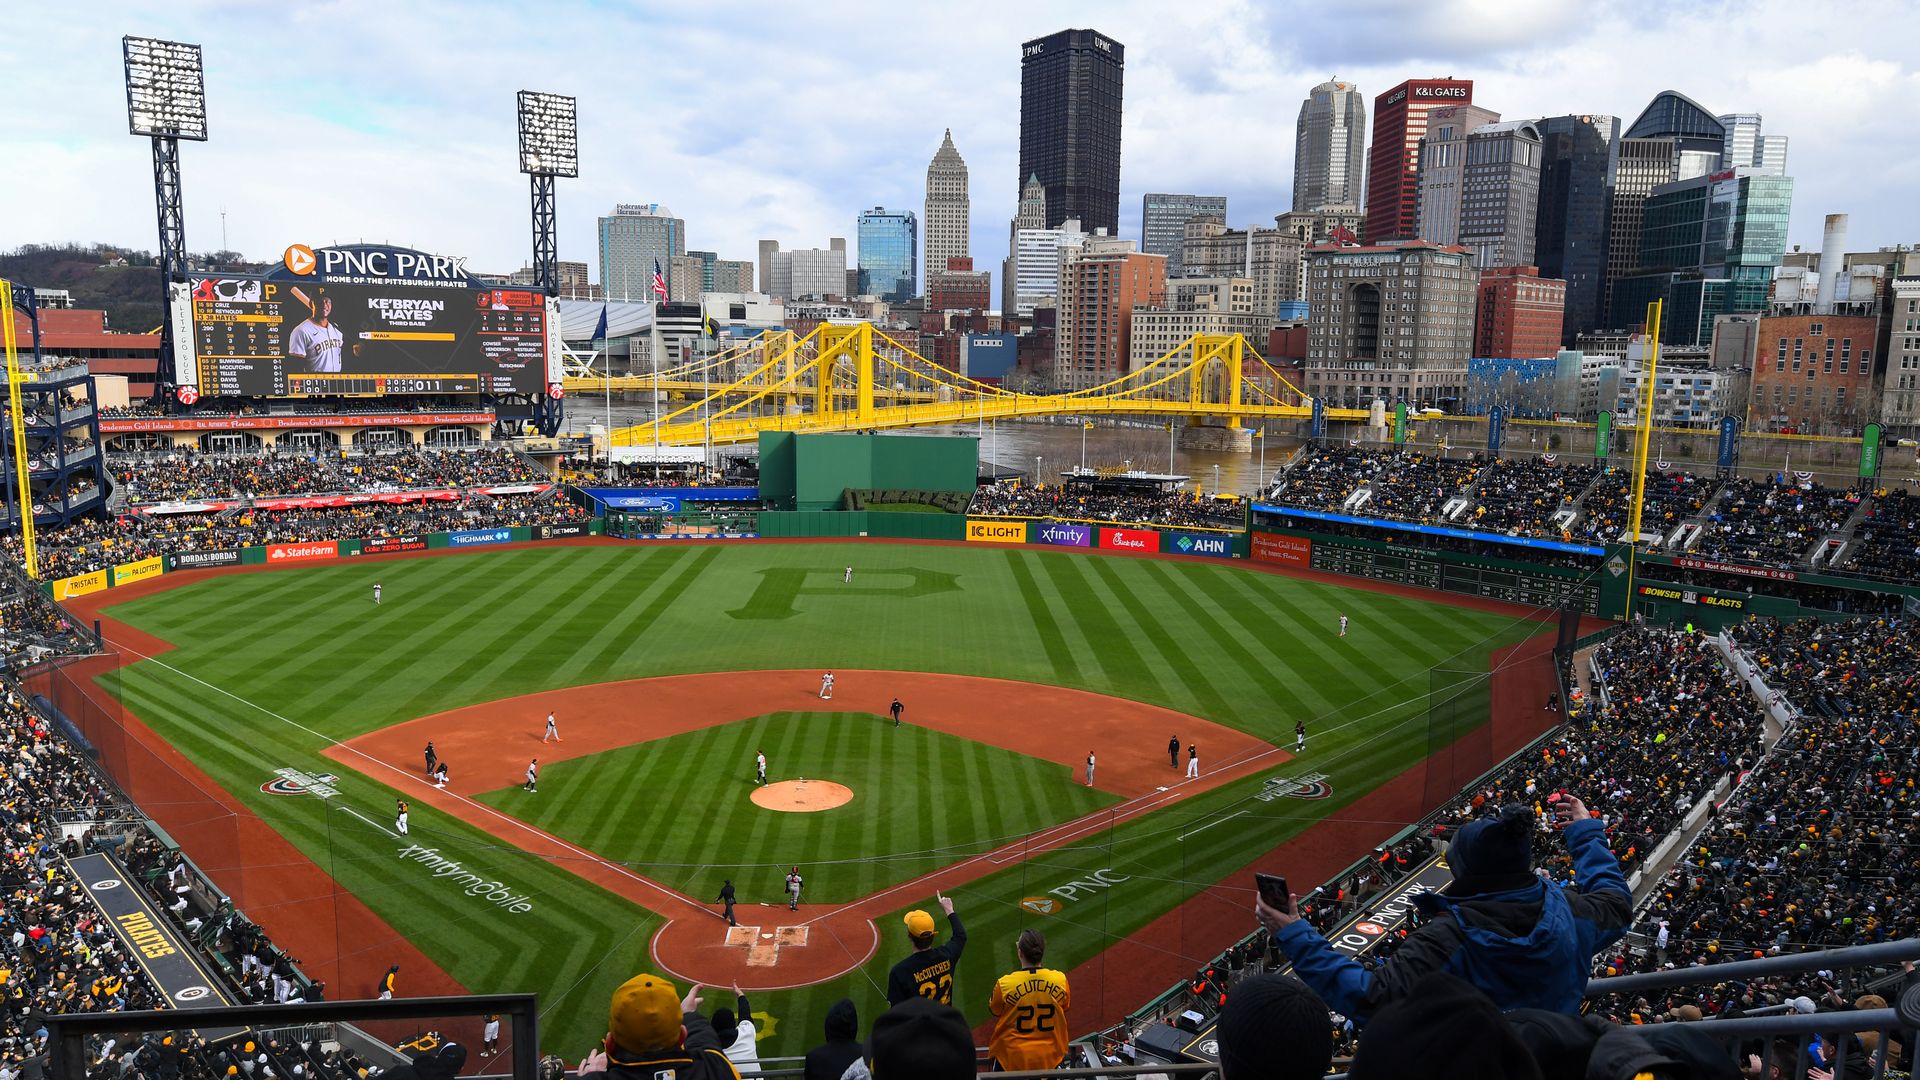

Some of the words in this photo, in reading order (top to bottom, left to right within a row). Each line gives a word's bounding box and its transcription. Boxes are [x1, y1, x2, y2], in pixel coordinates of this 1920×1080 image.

[1022, 43, 1044, 58] UPMC
[1094, 37, 1112, 53] UPMC
[1415, 87, 1433, 96] K&L
[1434, 87, 1466, 97] GATES
[321, 249, 388, 276] PNC
[394, 253, 468, 280] PARK
[326, 275, 351, 284] HOME
[385, 279, 434, 287] PITTSBURGH
[435, 280, 468, 289] PIRATES
[264, 284, 278, 301] P
[368, 298, 445, 312] KE'BRYAN
[380, 309, 434, 322] HAYES
[181, 337, 189, 351] GO
[416, 381, 424, 391] 0
[426, 381, 431, 391] 1
[435, 381, 440, 391] 1
[133, 422, 151, 430] Gulf
[152, 422, 175, 430] Islands
[278, 419, 308, 428] Bradenton
[309, 418, 323, 426] Gulf
[1865, 446, 1873, 461] AHN
[1127, 470, 1147, 479] TIME
[553, 527, 579, 535] BETMGM
[971, 526, 984, 537] IC
[987, 527, 1021, 538] LIGHT
[1042, 527, 1084, 544] xfinity
[401, 542, 425, 550] SUGAR
[456, 534, 494, 544] HIGHMARK
[1194, 539, 1224, 553] AHN
[1253, 536, 1277, 547] Bradenton
[1278, 540, 1291, 549] Gulf
[1291, 543, 1308, 552] Islands
[287, 548, 310, 558] State
[311, 546, 334, 556] Farm
[1327, 541, 1377, 552] NATIONAL
[181, 554, 208, 563] BORDAS
[210, 552, 237, 561] BORDAS
[131, 568, 139, 576] PA
[139, 564, 161, 575] LOTTERY
[1462, 561, 1524, 574] AMERICAN
[1533, 572, 1580, 583] LEAGUE
[1720, 563, 1749, 574] delicious
[1751, 567, 1768, 576] seats
[70, 577, 99, 589] TRISTATE
[1645, 587, 1681, 599] BOWSER
[1707, 597, 1743, 609] BLASTS
[397, 844, 468, 877] xfinity
[452, 874, 532, 913] mobile
[1048, 868, 1130, 901] PNC
[1332, 934, 1368, 951] TO
[1368, 903, 1407, 925] PNC
[116, 911, 175, 959] PIRATES
[913, 959, 951, 983] McCUTCHEN
[918, 973, 952, 1005] 22
[1005, 979, 1066, 1007] McCUTCHEN
[1016, 1004, 1055, 1033] 22
